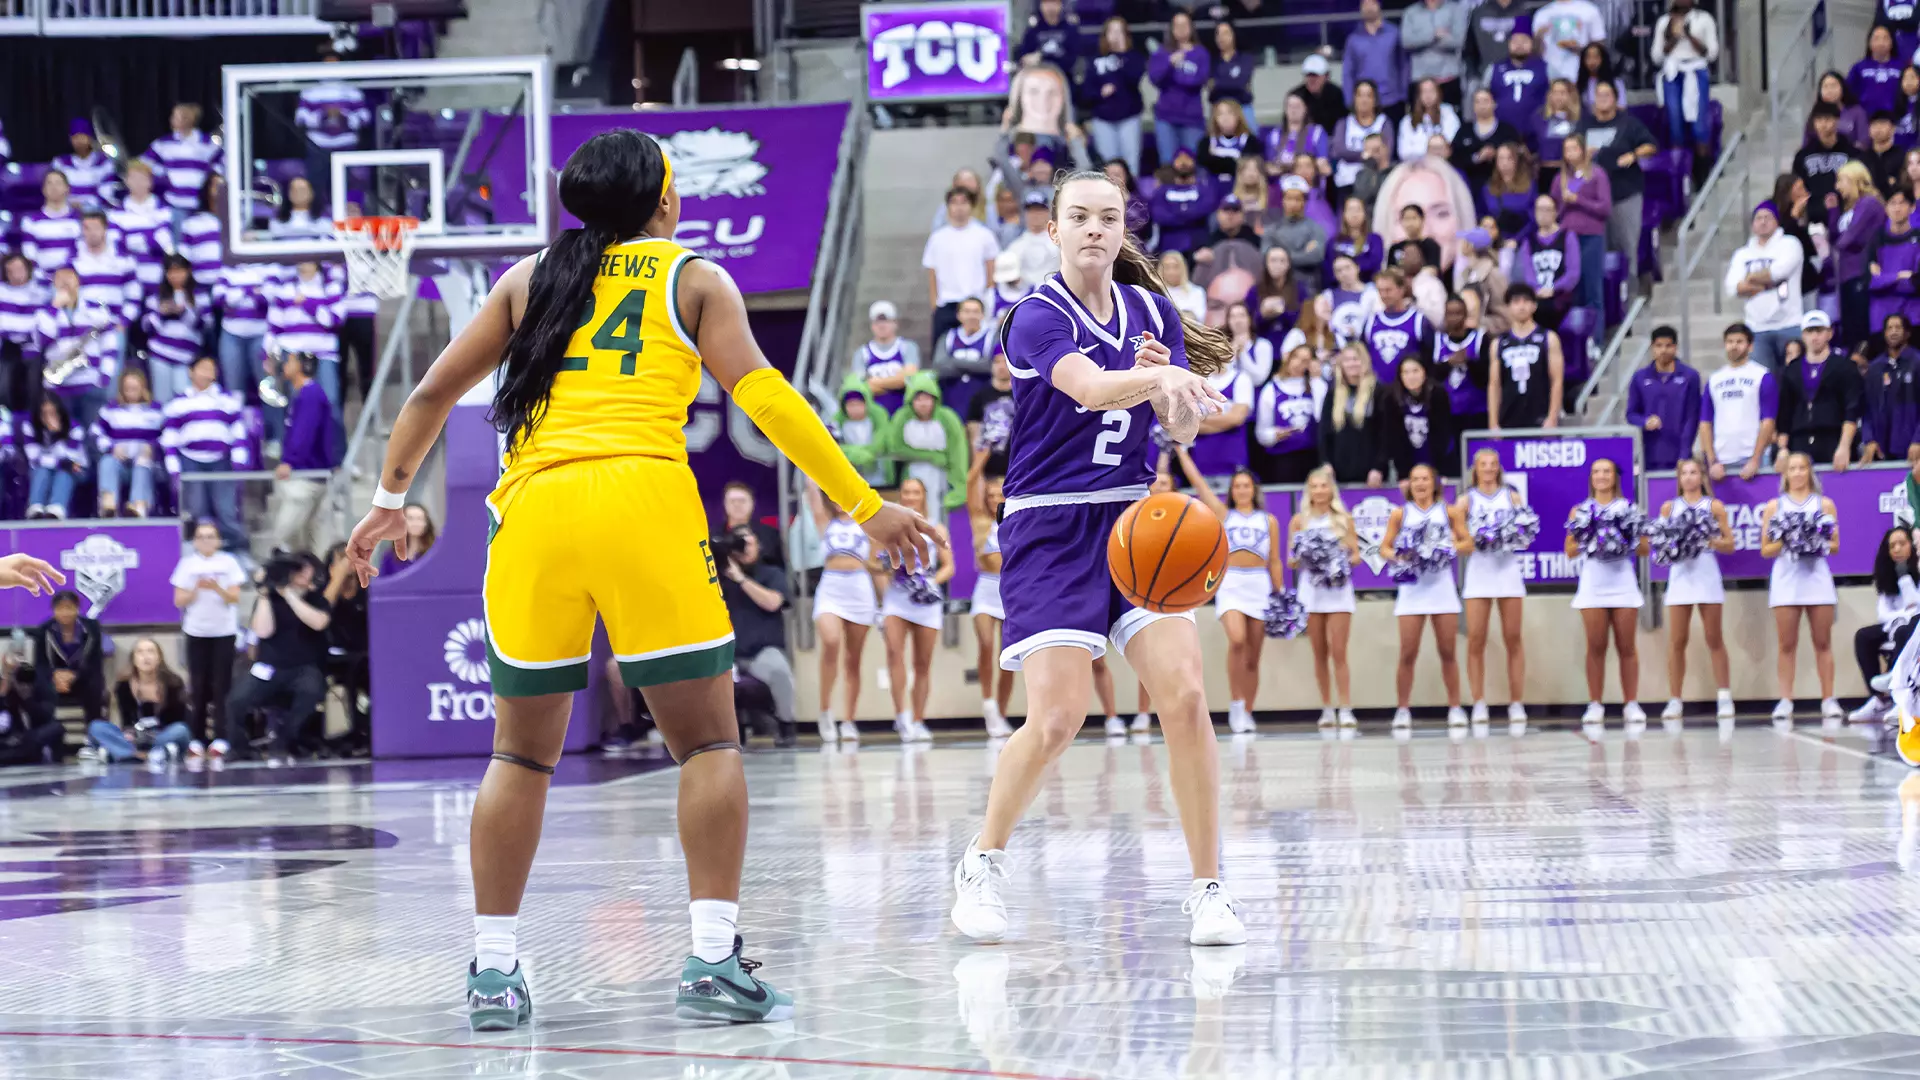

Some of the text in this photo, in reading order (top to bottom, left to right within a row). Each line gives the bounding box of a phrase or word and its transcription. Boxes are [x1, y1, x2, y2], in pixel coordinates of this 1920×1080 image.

[873, 20, 1000, 88] TCU
[1091, 409, 1132, 466] 2
[1514, 440, 1587, 469] MISSED
